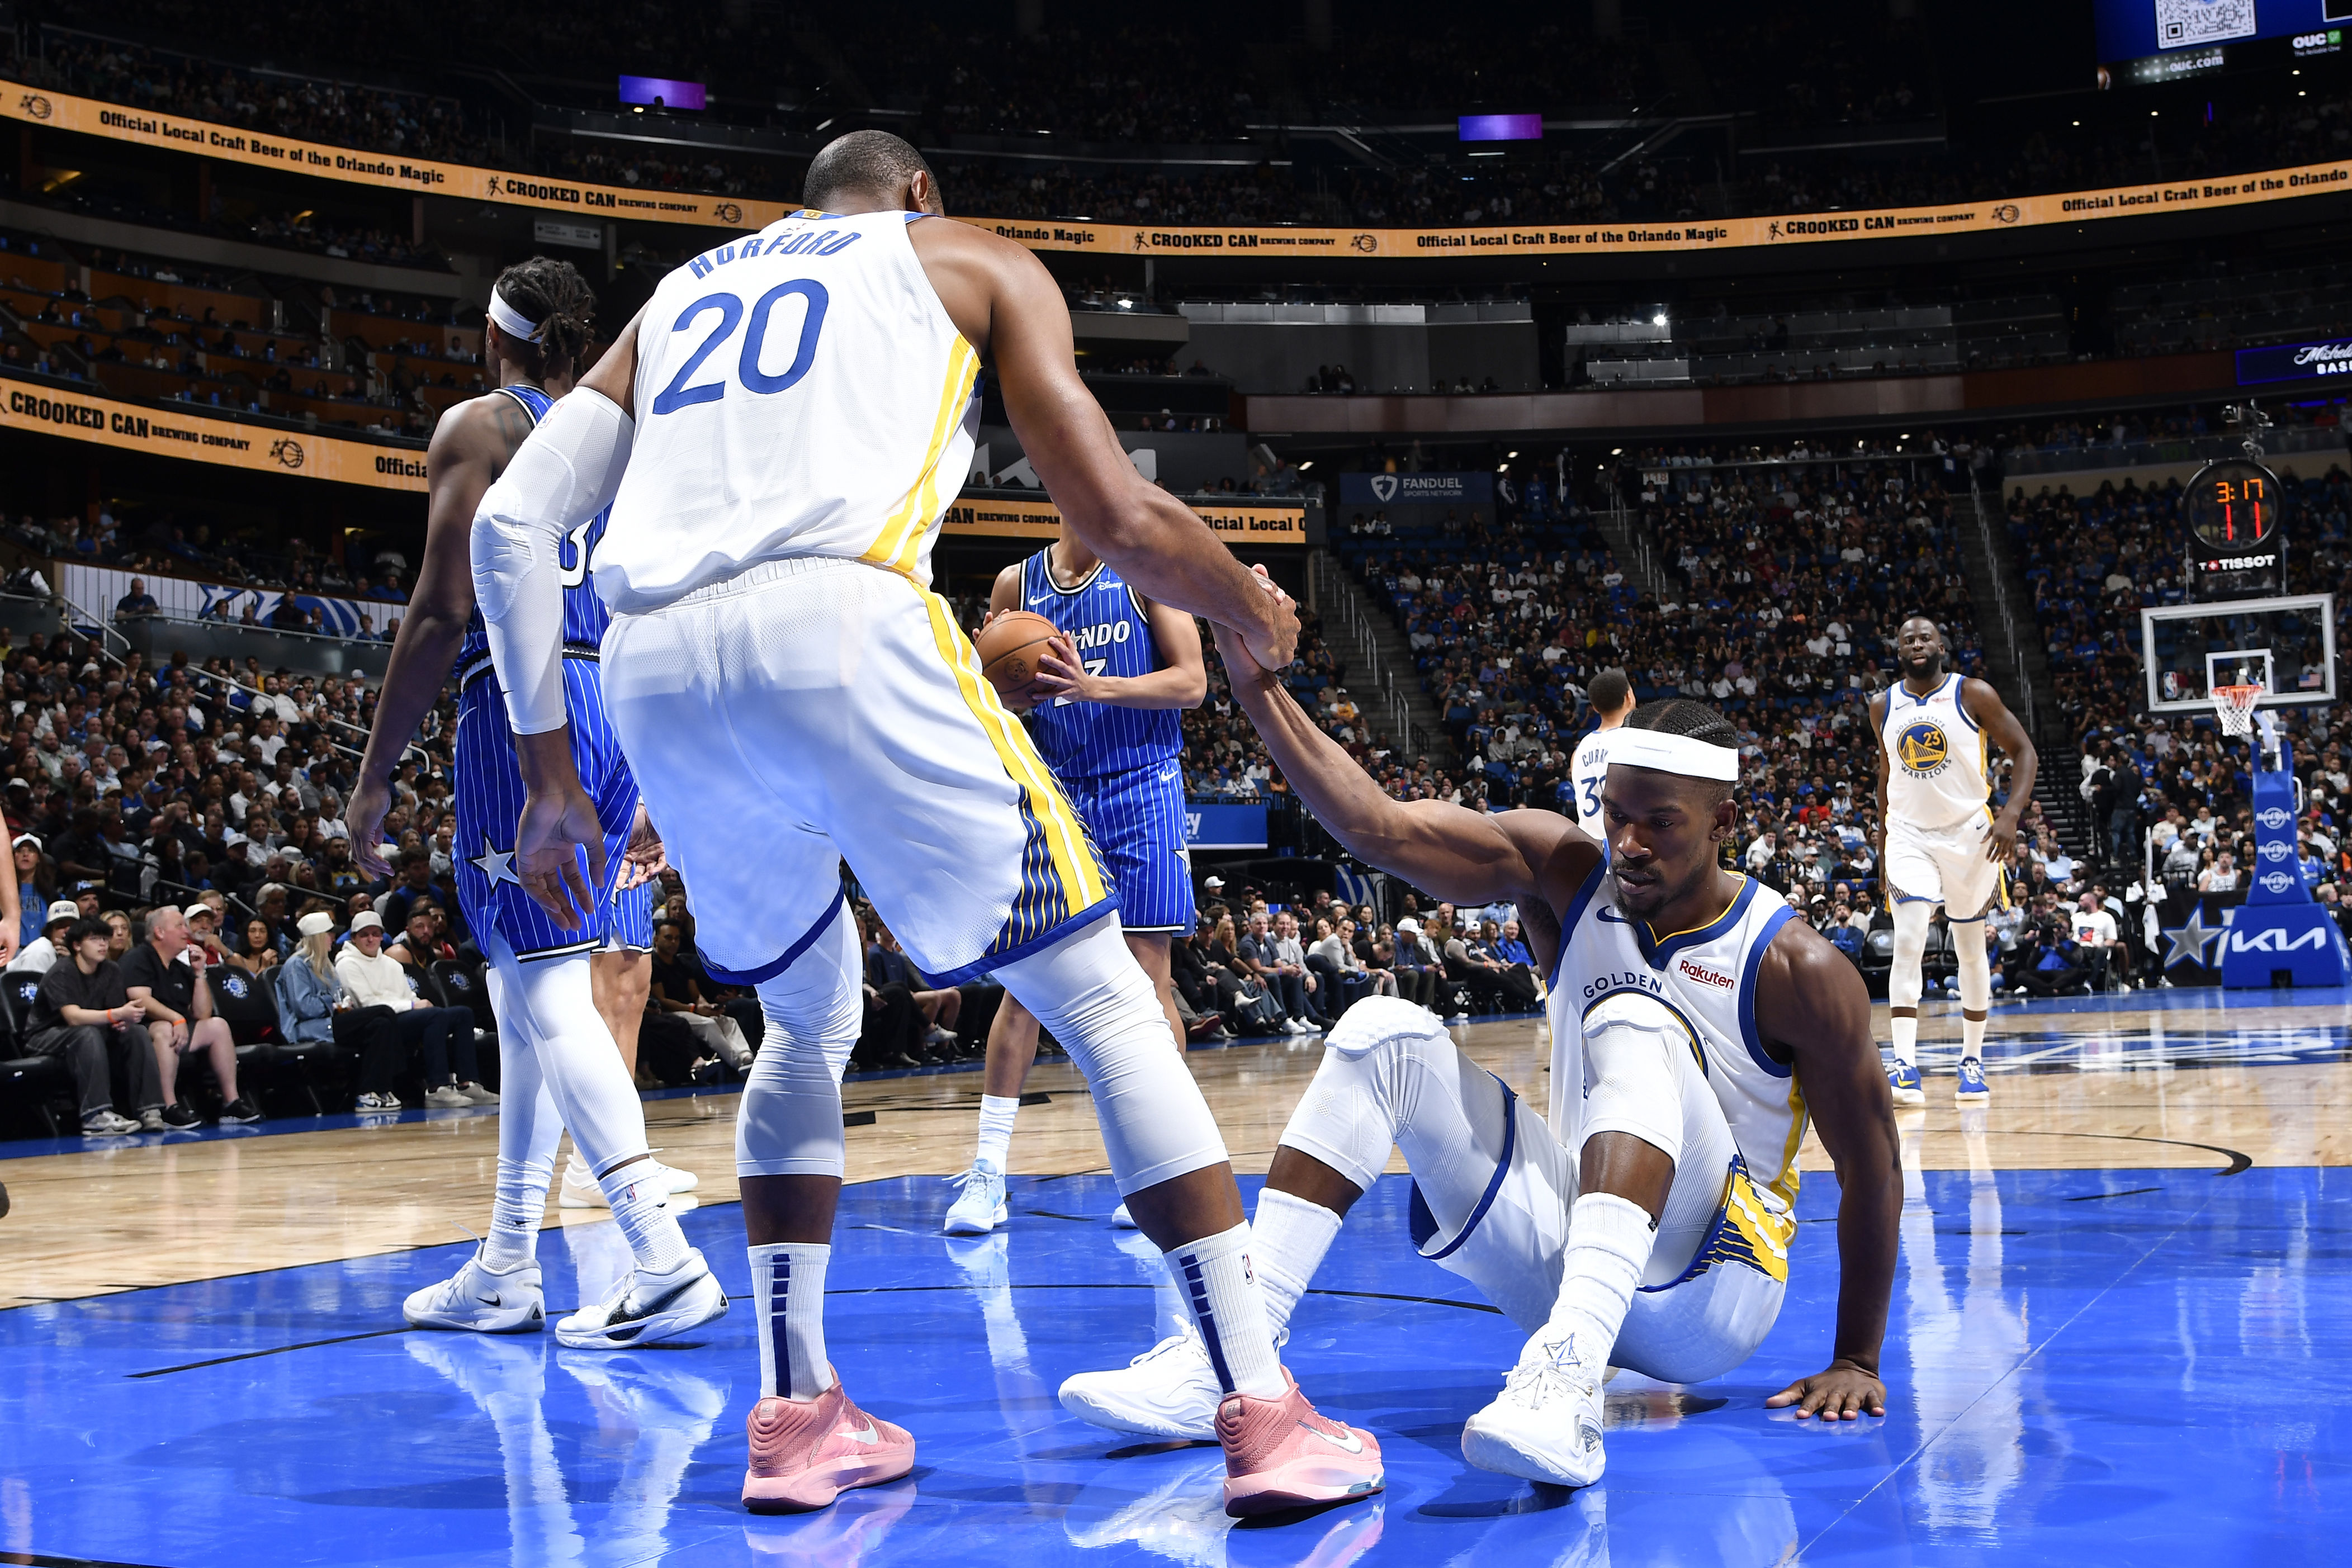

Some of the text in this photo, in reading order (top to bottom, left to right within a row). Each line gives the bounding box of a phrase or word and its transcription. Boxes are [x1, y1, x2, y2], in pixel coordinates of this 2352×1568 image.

[100, 110, 444, 184] Official Local Craft Beer of the Orlando Magic
[506, 179, 698, 213] CROOKED CAN BREWING COMPANY
[2062, 169, 2348, 212] Official Local Craft Beer of the Orlando
[1786, 219, 1859, 234] CROOKED
[1864, 216, 1895, 230] CAN
[1936, 213, 1975, 223] COMPANY
[996, 225, 1050, 240] Orlando
[1053, 228, 1095, 245] Magic
[1151, 233, 1223, 248] CROOKED
[1228, 235, 1258, 247] CAN
[1417, 228, 1727, 248] Official Local Craft Beer of the Orlando Magic
[688, 230, 862, 280] HORFORD
[652, 278, 829, 415] 20
[10, 391, 250, 451] CROOKED CAN BREWING COMPANY
[376, 456, 427, 478] Officia
[1403, 478, 1463, 489] FANDUEL
[2216, 478, 2264, 503] 3:17
[977, 512, 1020, 523] BREWING
[1023, 514, 1060, 524] COMPAN
[1249, 517, 1293, 531] Local
[2226, 501, 2262, 541] 11
[2218, 554, 2276, 571] TISSOT
[1095, 580, 1123, 591] Disney
[1895, 716, 1946, 735] GOLDEN STATE
[1923, 730, 1941, 747] 23
[1901, 758, 1952, 780] WARRIORS
[1583, 972, 1662, 998] GOLDEN
[1679, 959, 1735, 990] Rakuten
